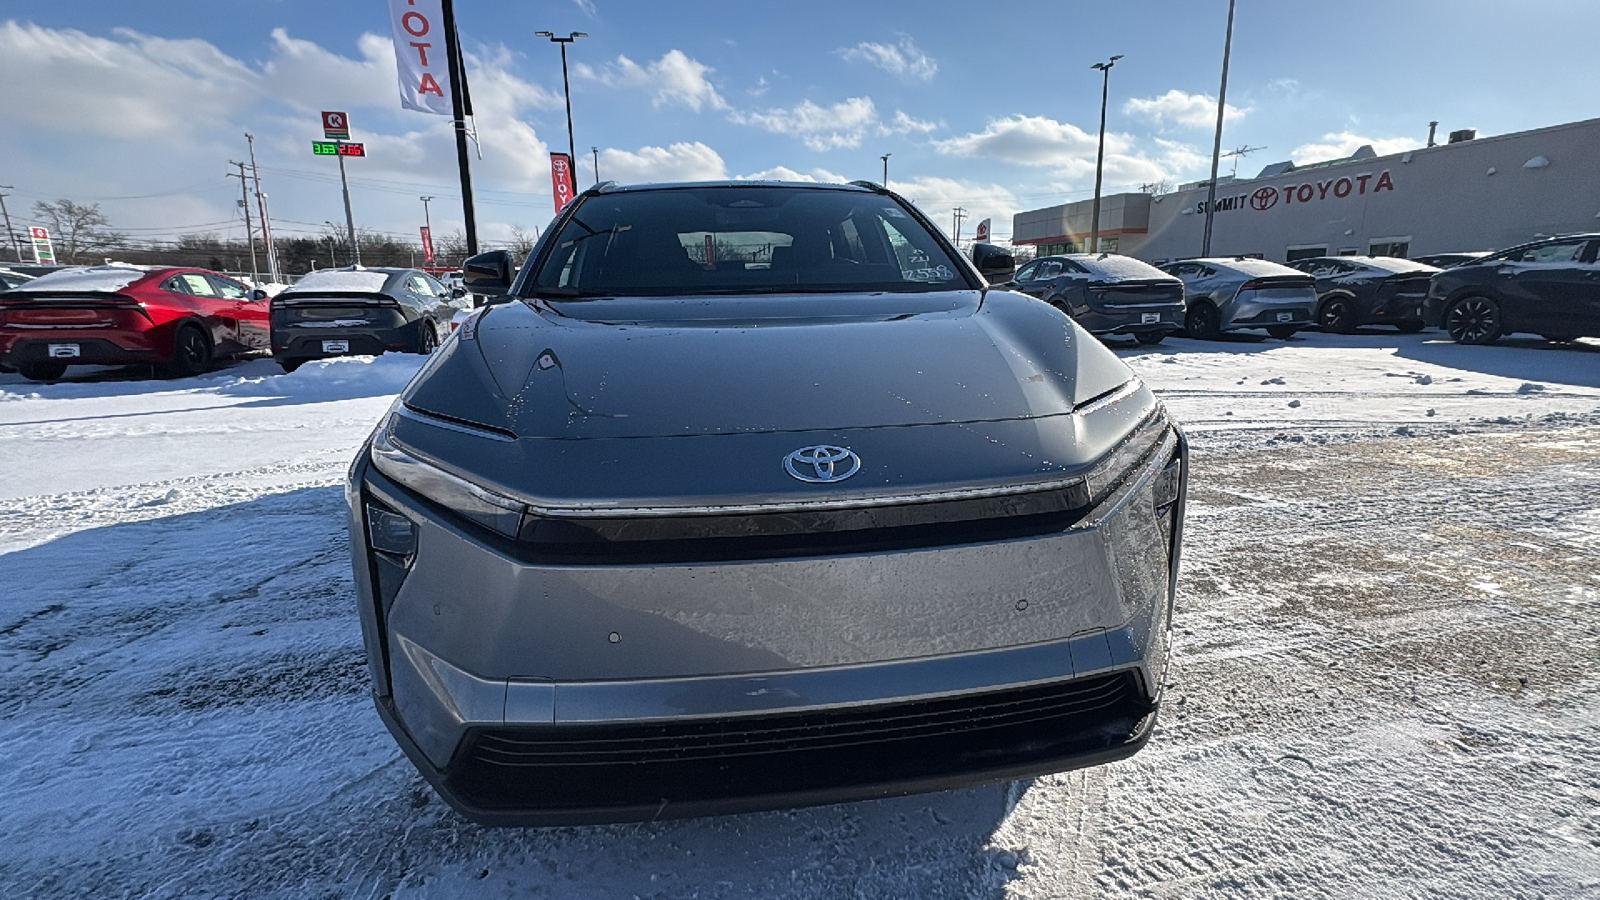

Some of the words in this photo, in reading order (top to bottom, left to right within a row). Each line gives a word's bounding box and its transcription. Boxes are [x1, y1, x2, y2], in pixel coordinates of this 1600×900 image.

[401, 0, 444, 98] OTA
[557, 172, 568, 210] TOY
[1283, 169, 1394, 205] TOYOTA
